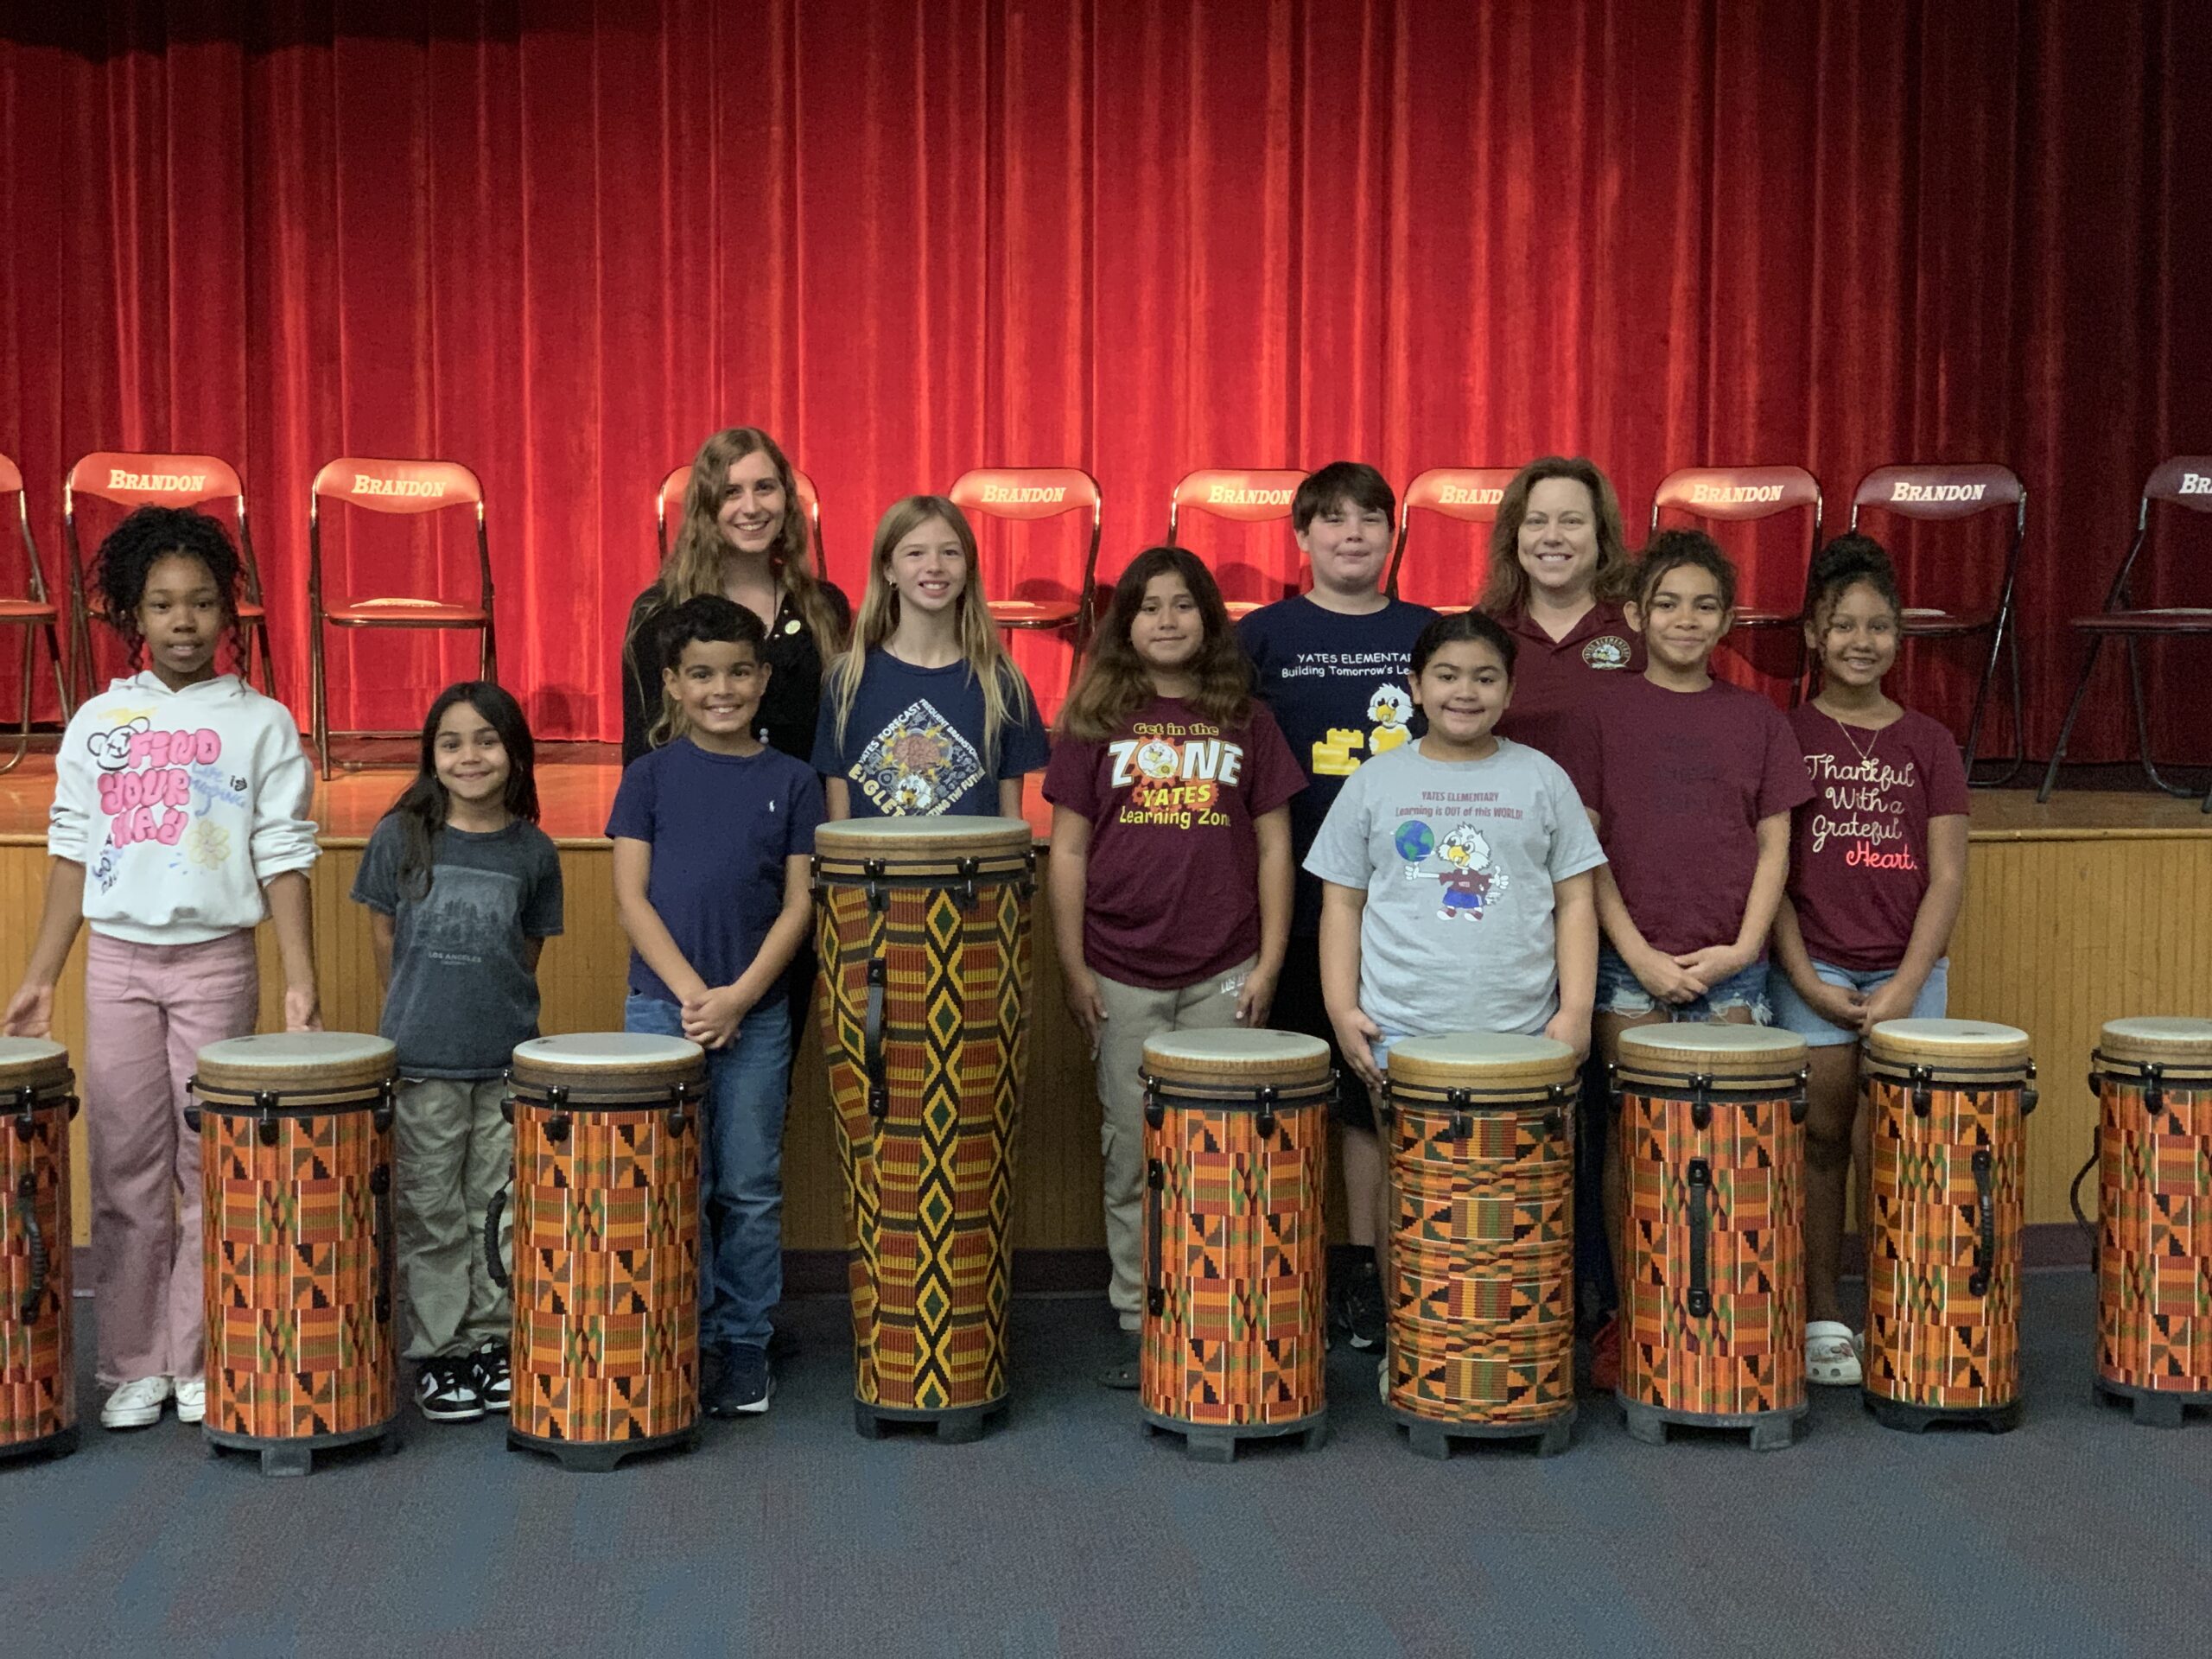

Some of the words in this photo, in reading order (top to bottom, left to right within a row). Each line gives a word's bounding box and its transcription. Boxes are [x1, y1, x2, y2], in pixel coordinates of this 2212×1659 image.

[107, 469, 207, 492] BRANDON
[351, 474, 447, 497] BRANDON
[2178, 473, 2212, 494] BR
[981, 484, 1067, 503] BRANDON
[1207, 485, 1294, 505] BRANDON
[1438, 485, 1503, 505] BRAND
[1688, 484, 1784, 503] BRANDON
[1890, 482, 1986, 501] BRANDON
[1297, 652, 1338, 664] YATES
[1341, 652, 1411, 664] ELEMENTA
[1281, 665, 1325, 678] Building
[1328, 664, 1393, 677] Tomorrow's
[1396, 664, 1410, 675] Le
[877, 702, 921, 741] FORECAST
[1134, 723, 1164, 734] Get
[1167, 722, 1186, 735] in
[1189, 722, 1219, 735] the
[1804, 753, 1915, 791] Thankful
[98, 768, 190, 815] YOUR
[1142, 784, 1211, 807] YATES
[1422, 791, 1446, 802] YATES
[1447, 791, 1499, 803] ELEMENTARY
[1825, 786, 1888, 813] With
[1890, 800, 1905, 814] a
[1120, 805, 1191, 830] Learning
[1198, 808, 1231, 827] Zon
[1395, 804, 1433, 817] Learning
[1435, 806, 1444, 816] is
[1445, 806, 1460, 817] OUT
[1463, 807, 1473, 817] of
[1475, 807, 1491, 817] this
[1812, 812, 1903, 853] Grateful
